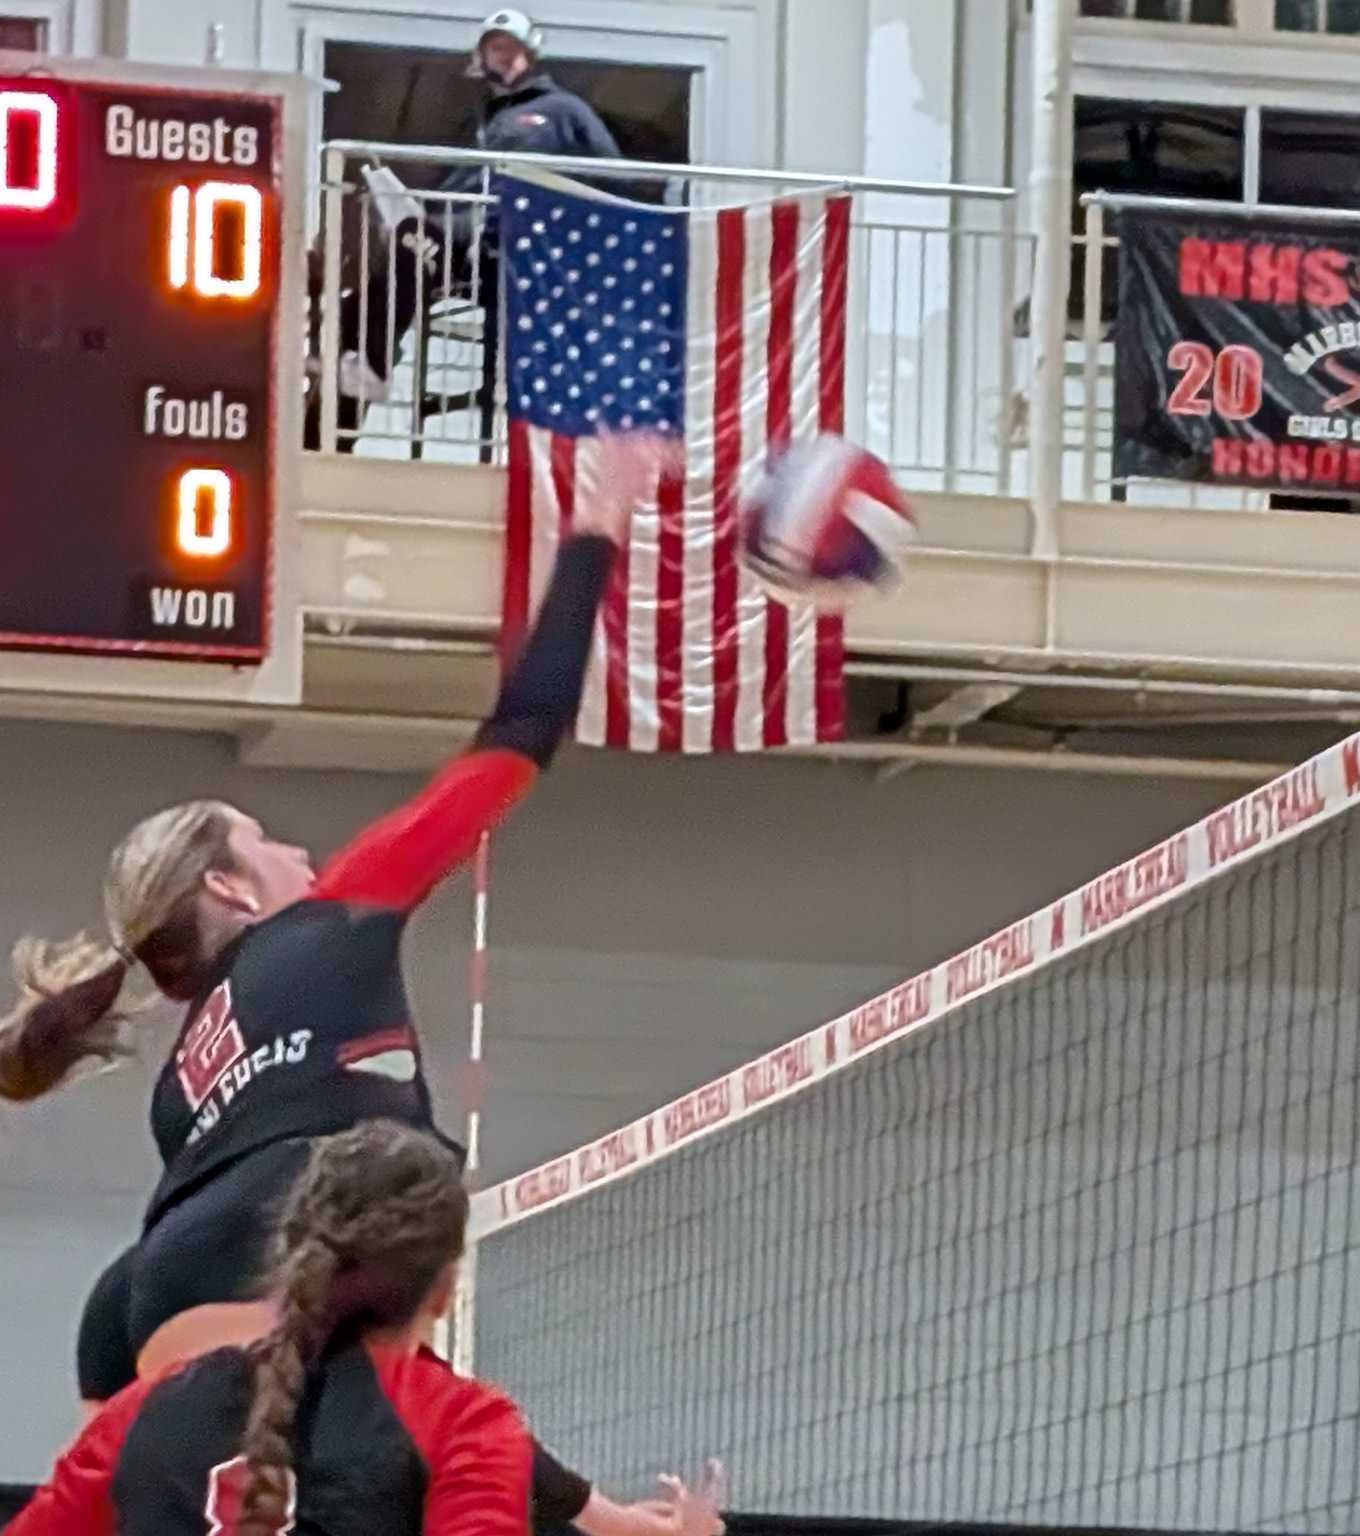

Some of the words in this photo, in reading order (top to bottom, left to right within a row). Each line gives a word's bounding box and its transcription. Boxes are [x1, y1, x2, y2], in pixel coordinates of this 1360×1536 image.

[105, 105, 259, 166] Guests
[168, 181, 263, 298] 10
[144, 387, 249, 441] fouls
[1166, 340, 1264, 420] 20
[177, 468, 233, 557] 0
[150, 589, 235, 630] won
